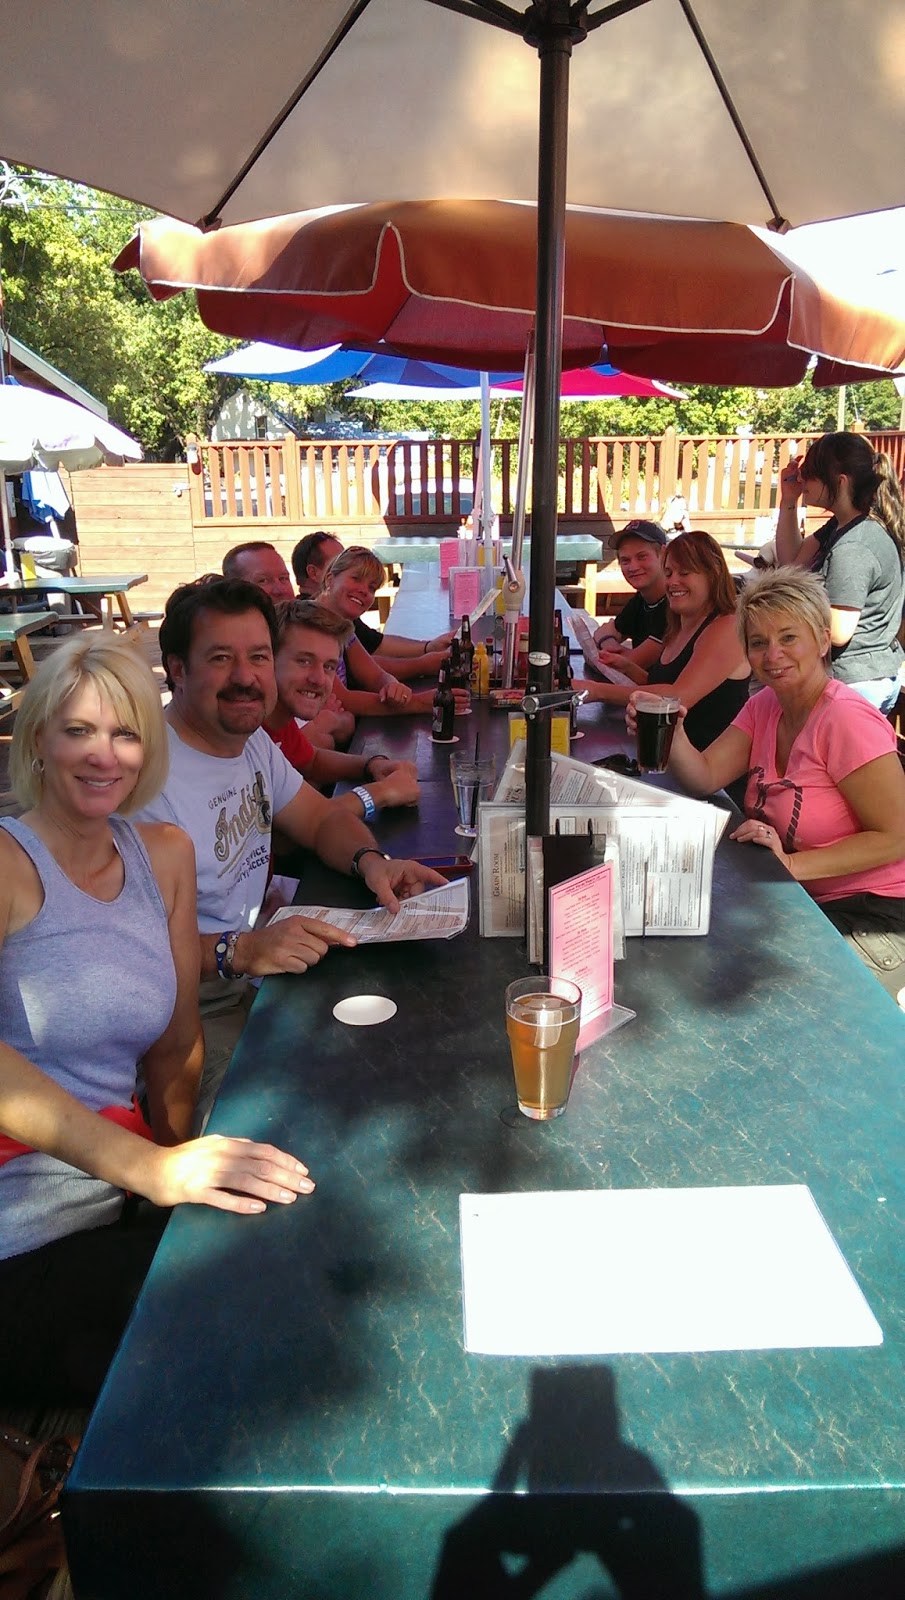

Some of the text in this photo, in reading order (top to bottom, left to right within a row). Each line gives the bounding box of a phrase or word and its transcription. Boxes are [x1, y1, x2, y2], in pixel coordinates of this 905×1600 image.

[208, 786, 238, 810] GENUINE
[492, 853, 500, 897] GRAIN ROOM
